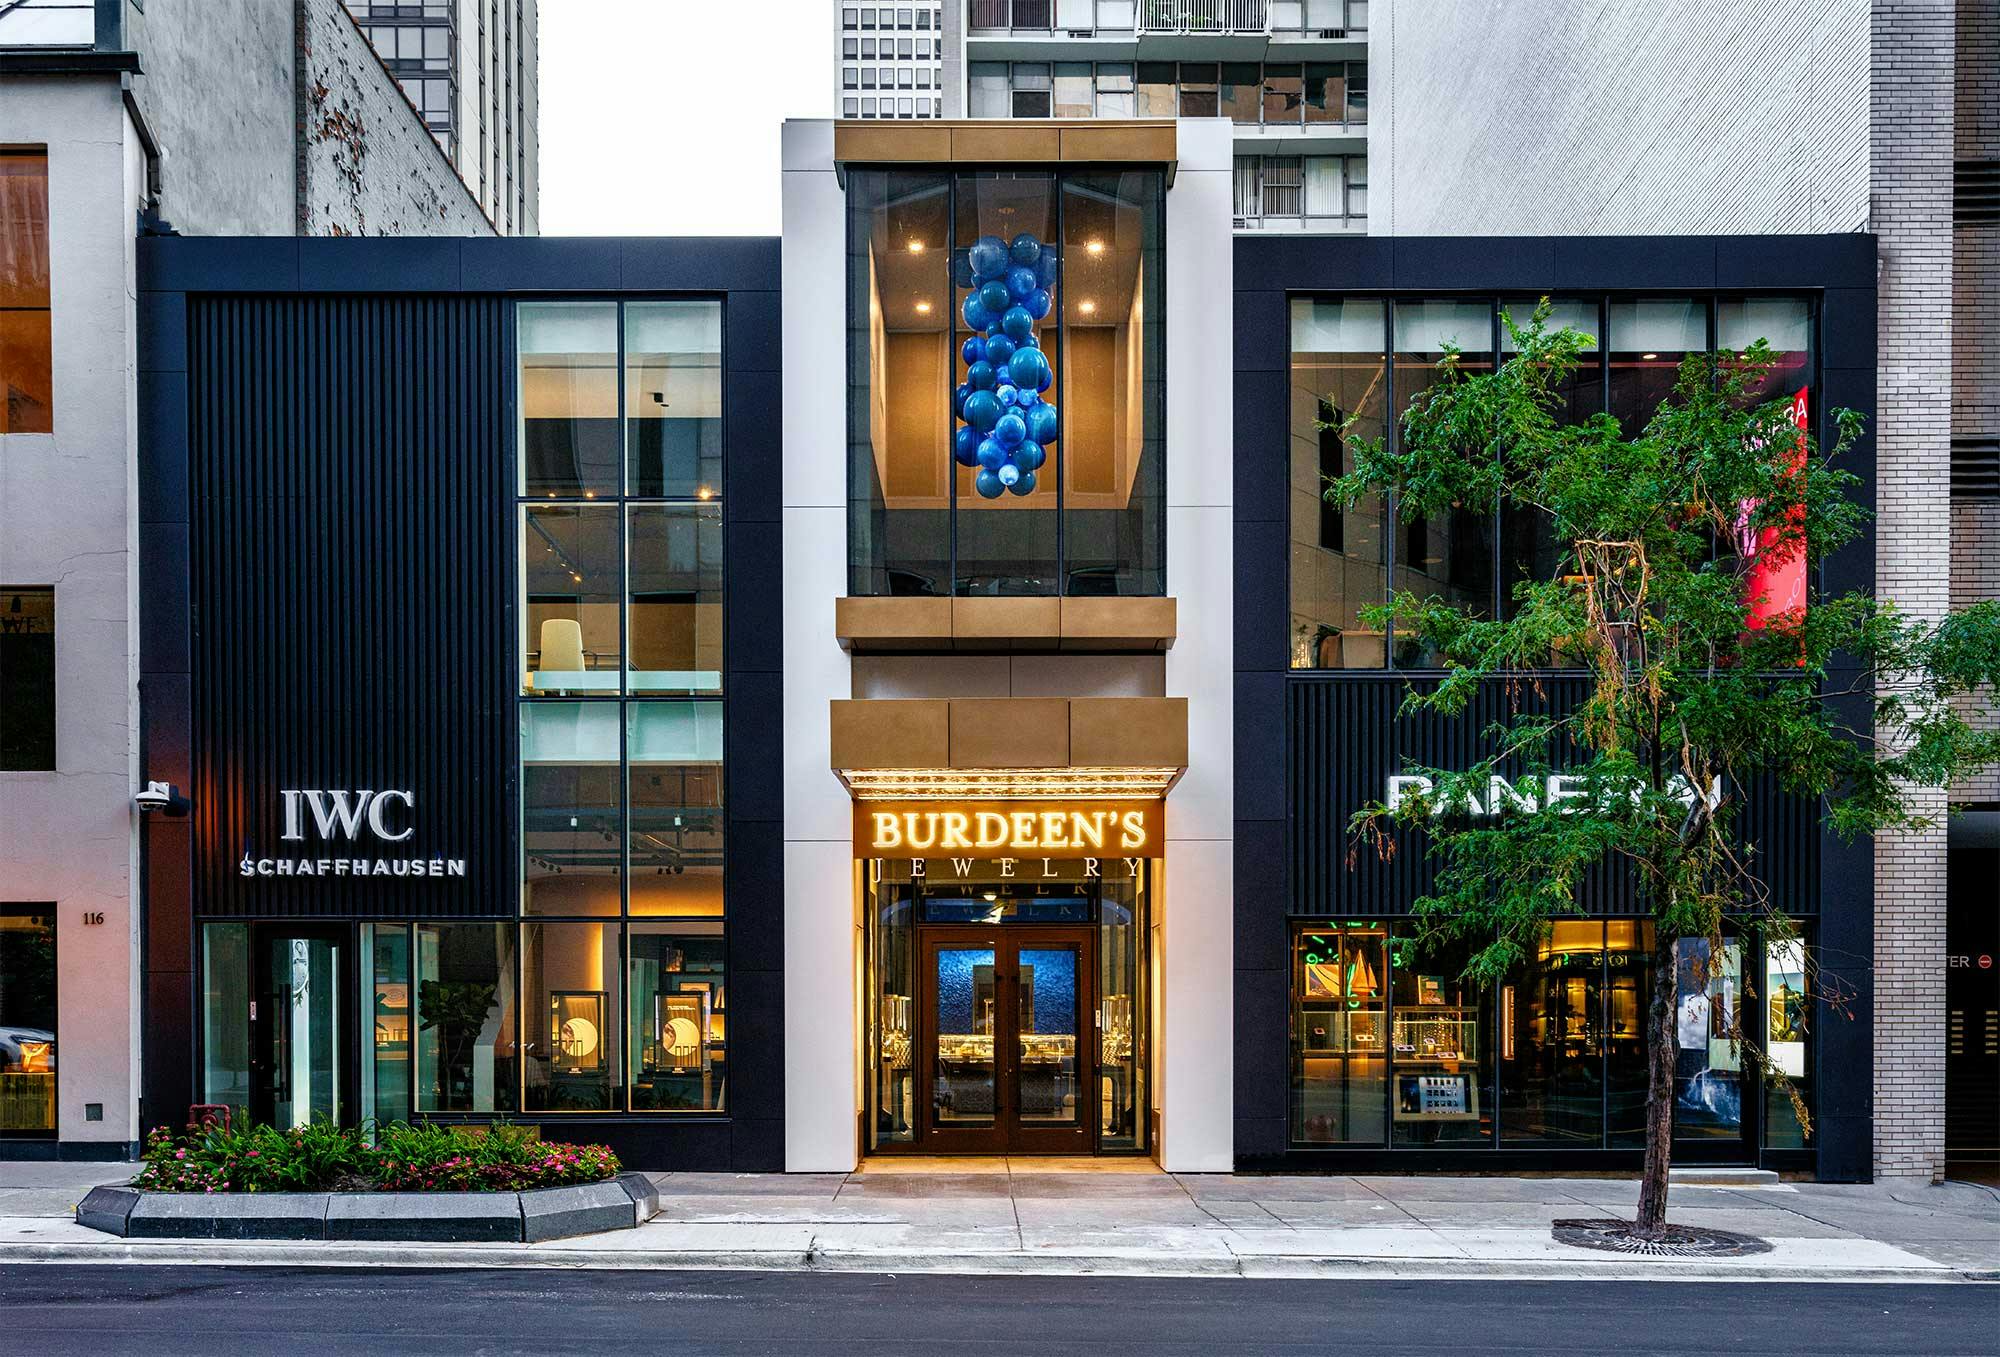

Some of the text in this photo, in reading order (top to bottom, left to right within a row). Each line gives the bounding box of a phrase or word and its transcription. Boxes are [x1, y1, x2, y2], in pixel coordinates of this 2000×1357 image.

[280, 789, 415, 841] IWC
[871, 810, 1147, 849] BURDEEN'S
[239, 857, 466, 877] SCHAFFHAUSEN
[873, 857, 1143, 883] JEWELRY
[83, 911, 105, 925] 116
